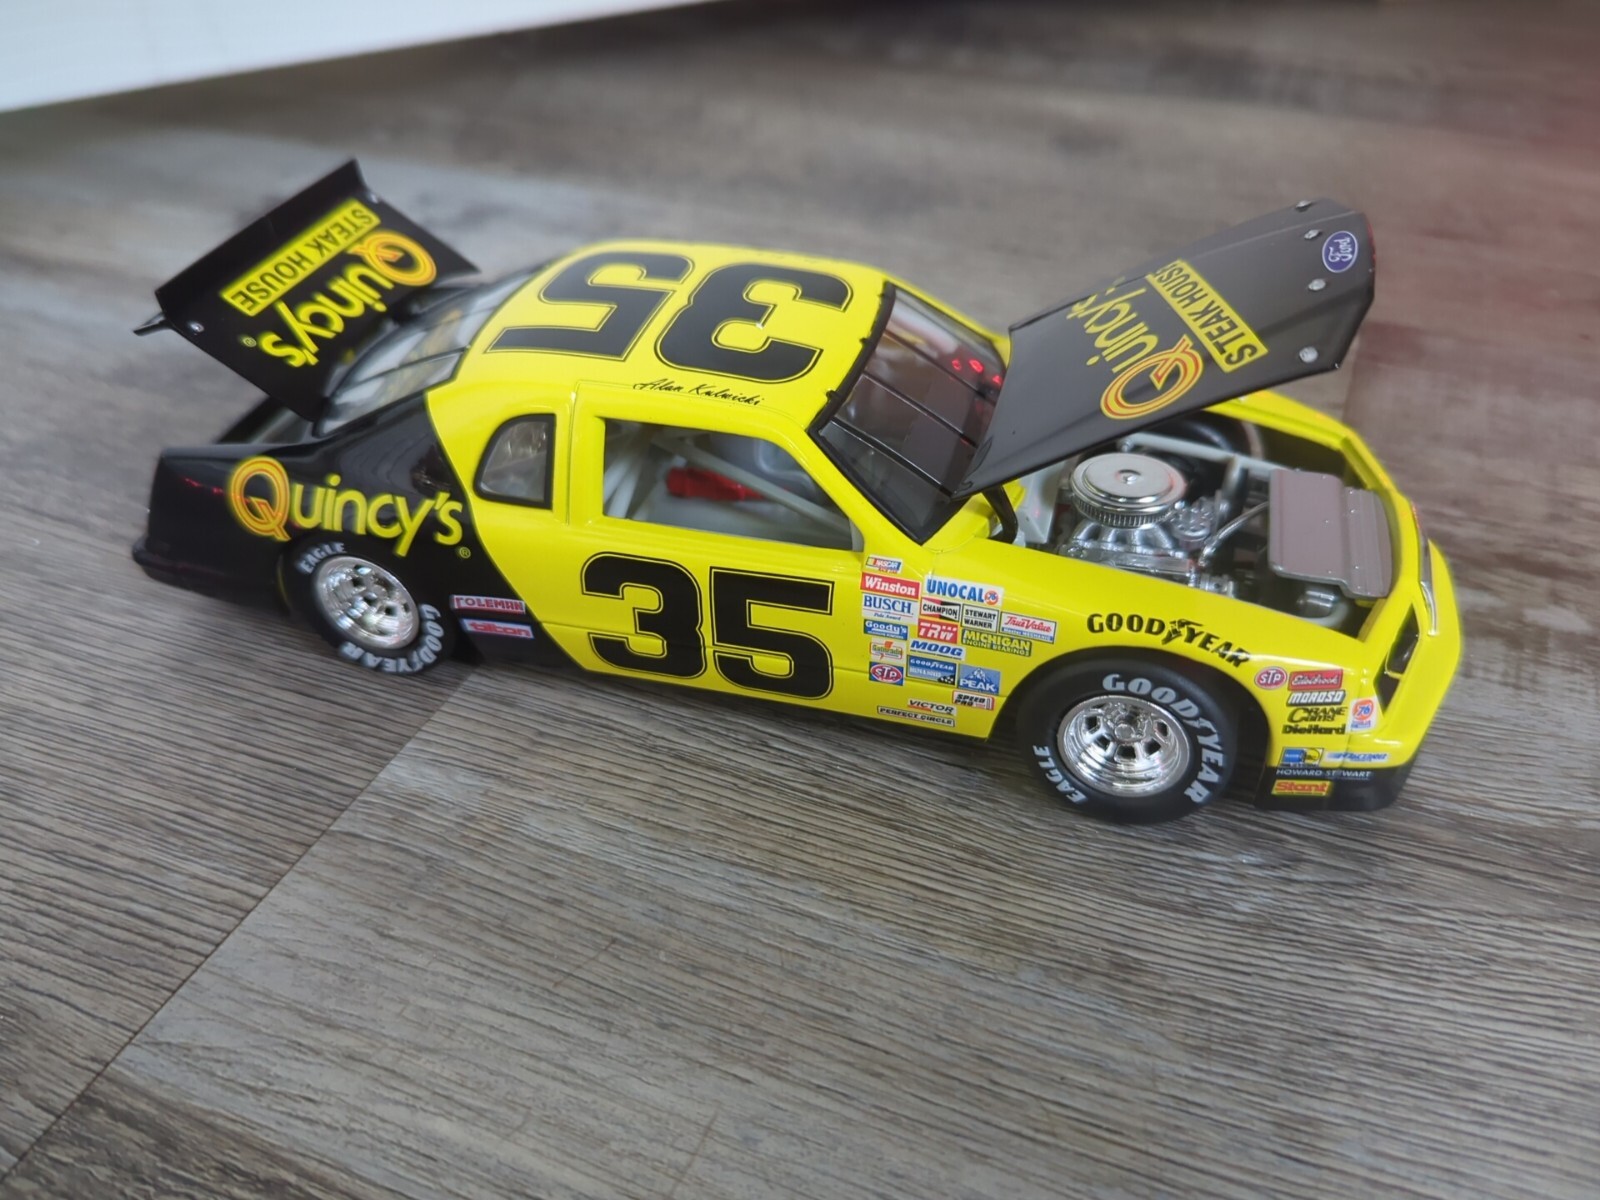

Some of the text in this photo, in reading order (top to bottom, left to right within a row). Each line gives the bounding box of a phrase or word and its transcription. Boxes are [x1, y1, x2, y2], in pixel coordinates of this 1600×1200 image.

[230, 207, 373, 311] STEAK HOUSE
[258, 229, 437, 367] Quincy's
[484, 250, 853, 384] 35
[1191, 300, 1258, 366] STEAK
[632, 378, 684, 391] Alan
[231, 456, 463, 557] Quincy's
[296, 541, 346, 574] EAGLE
[875, 558, 899, 570] NASCAR
[864, 575, 916, 597] Winston
[926, 578, 984, 603] UNOCAL
[863, 595, 912, 614] BUSCH
[922, 603, 958, 617] CHAMPION
[964, 608, 997, 621] STEWART
[580, 551, 835, 700] 35
[865, 620, 907, 634] Goody's
[919, 622, 957, 640] TRW
[963, 618, 993, 630] WARNER
[338, 603, 444, 674] GOODYEAR
[964, 630, 1031, 651] MICHIGAN
[1087, 612, 1250, 668] GOODYEAR
[910, 640, 963, 657] MOOG
[874, 665, 898, 678] STP
[910, 658, 955, 671] GOODYEAR
[959, 679, 997, 692] PEAK
[1259, 669, 1283, 685] STP
[956, 693, 986, 704] SPEED
[1287, 690, 1345, 705] MOROSO
[879, 707, 953, 725] PERFECT CIRCLE
[909, 700, 955, 714] VICTOR
[1102, 673, 1226, 804] GOODYEAR
[1282, 724, 1346, 735] DieHard
[1032, 744, 1088, 805] EAGLE
[1276, 768, 1323, 777] HOWARD
